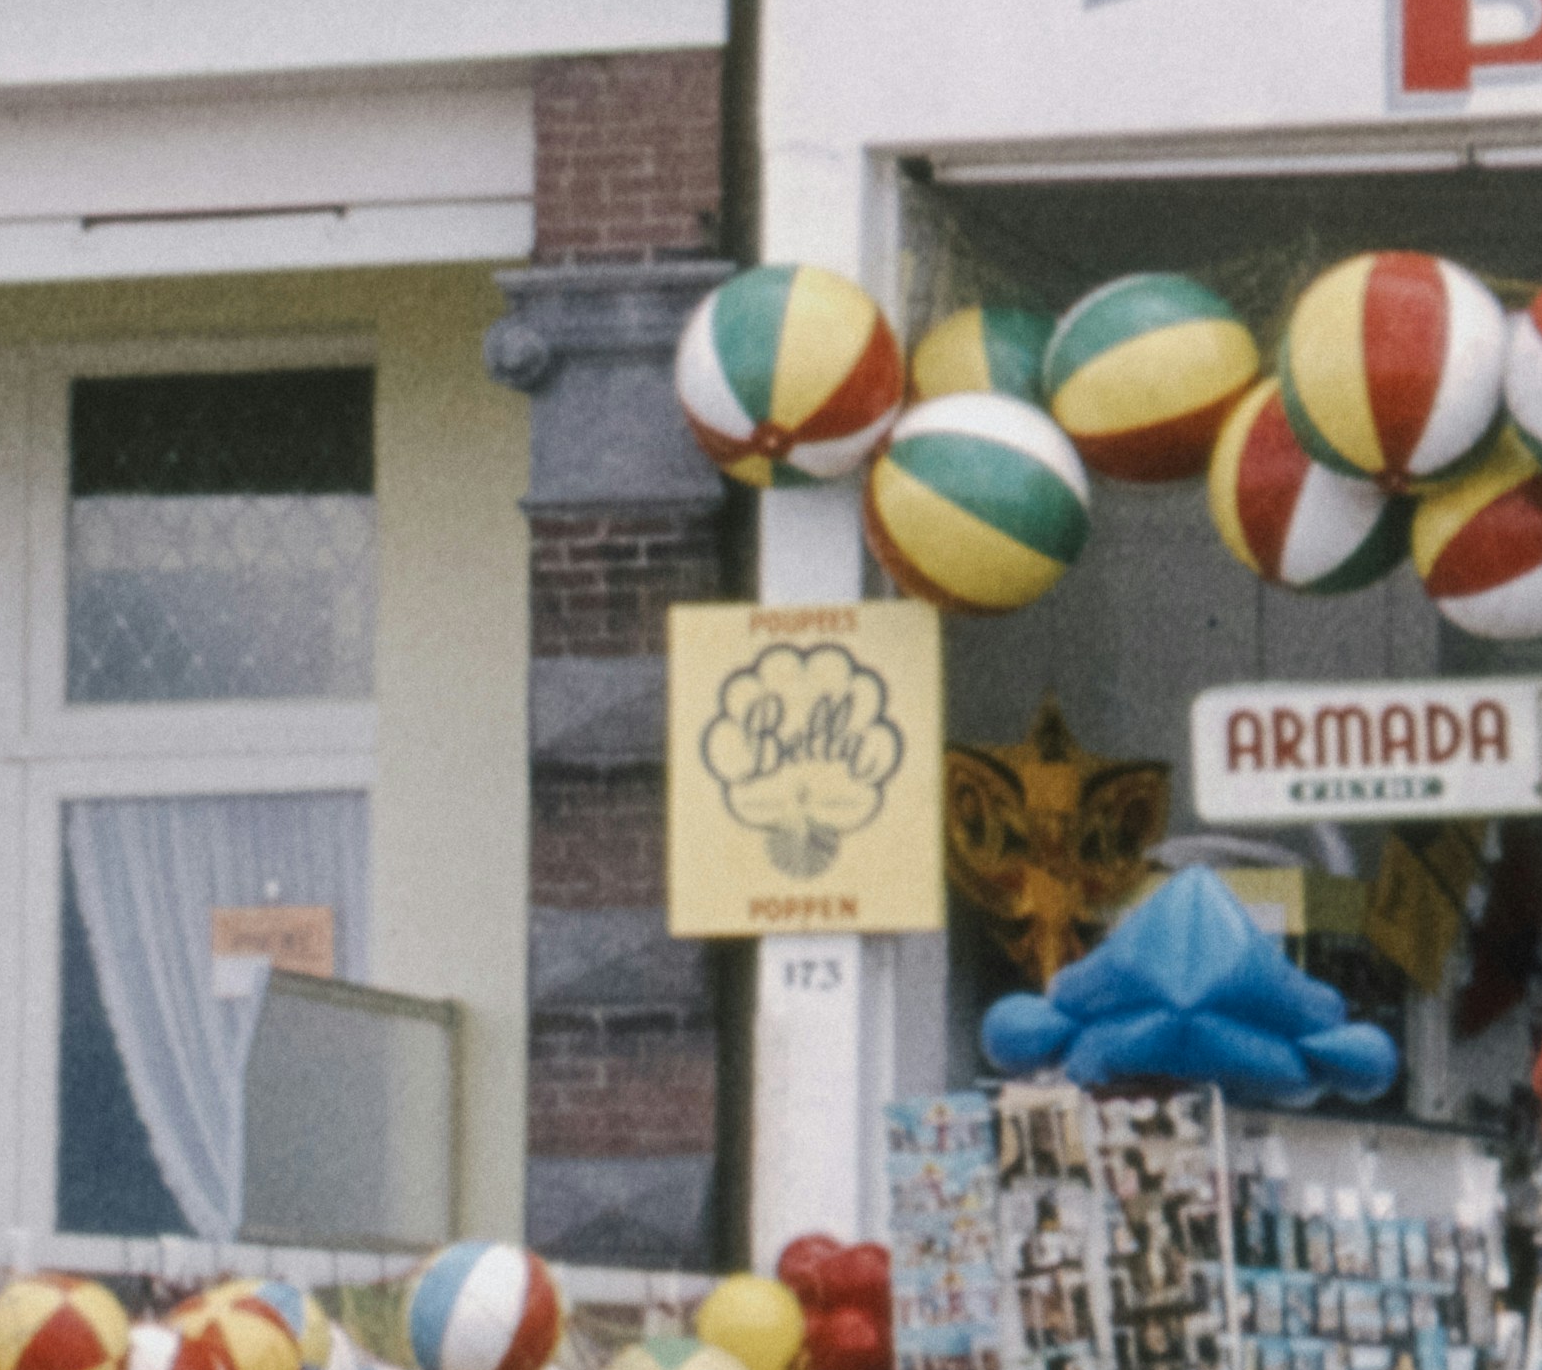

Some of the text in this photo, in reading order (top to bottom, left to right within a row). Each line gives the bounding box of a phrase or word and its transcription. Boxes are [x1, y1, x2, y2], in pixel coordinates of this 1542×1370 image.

[1225, 697, 1511, 773] ARMADA
[748, 895, 859, 922] POPPEN
[782, 957, 843, 993] 173
